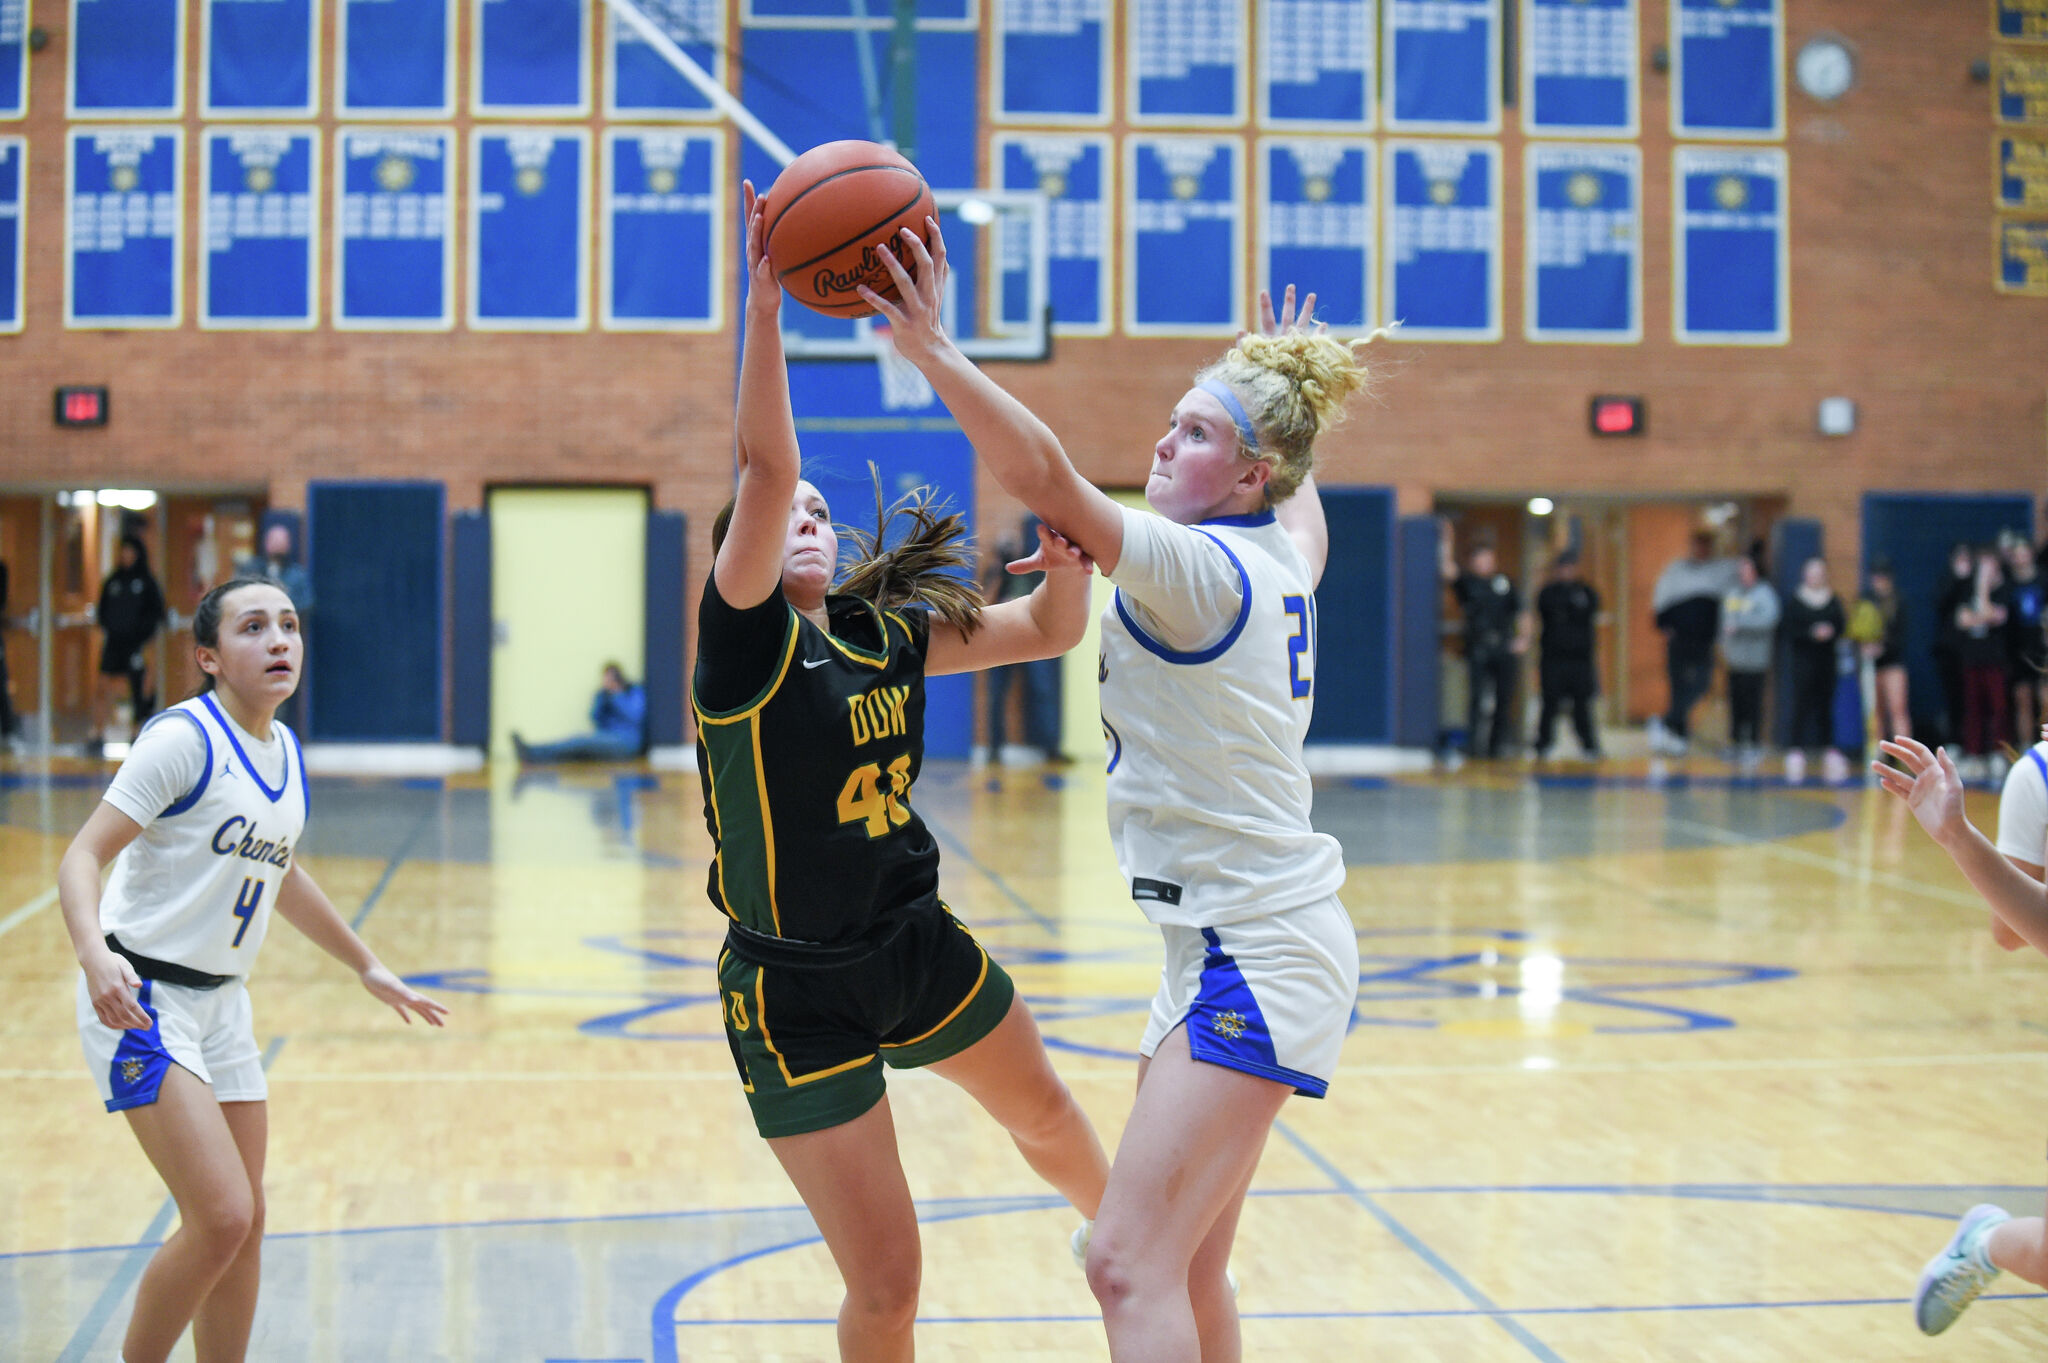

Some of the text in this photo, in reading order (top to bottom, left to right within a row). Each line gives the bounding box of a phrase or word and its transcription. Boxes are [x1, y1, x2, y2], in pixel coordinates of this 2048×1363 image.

[813, 225, 904, 298] Rawlig
[1281, 591, 1315, 701] 21
[848, 684, 911, 747] DOW
[231, 875, 265, 949] 4
